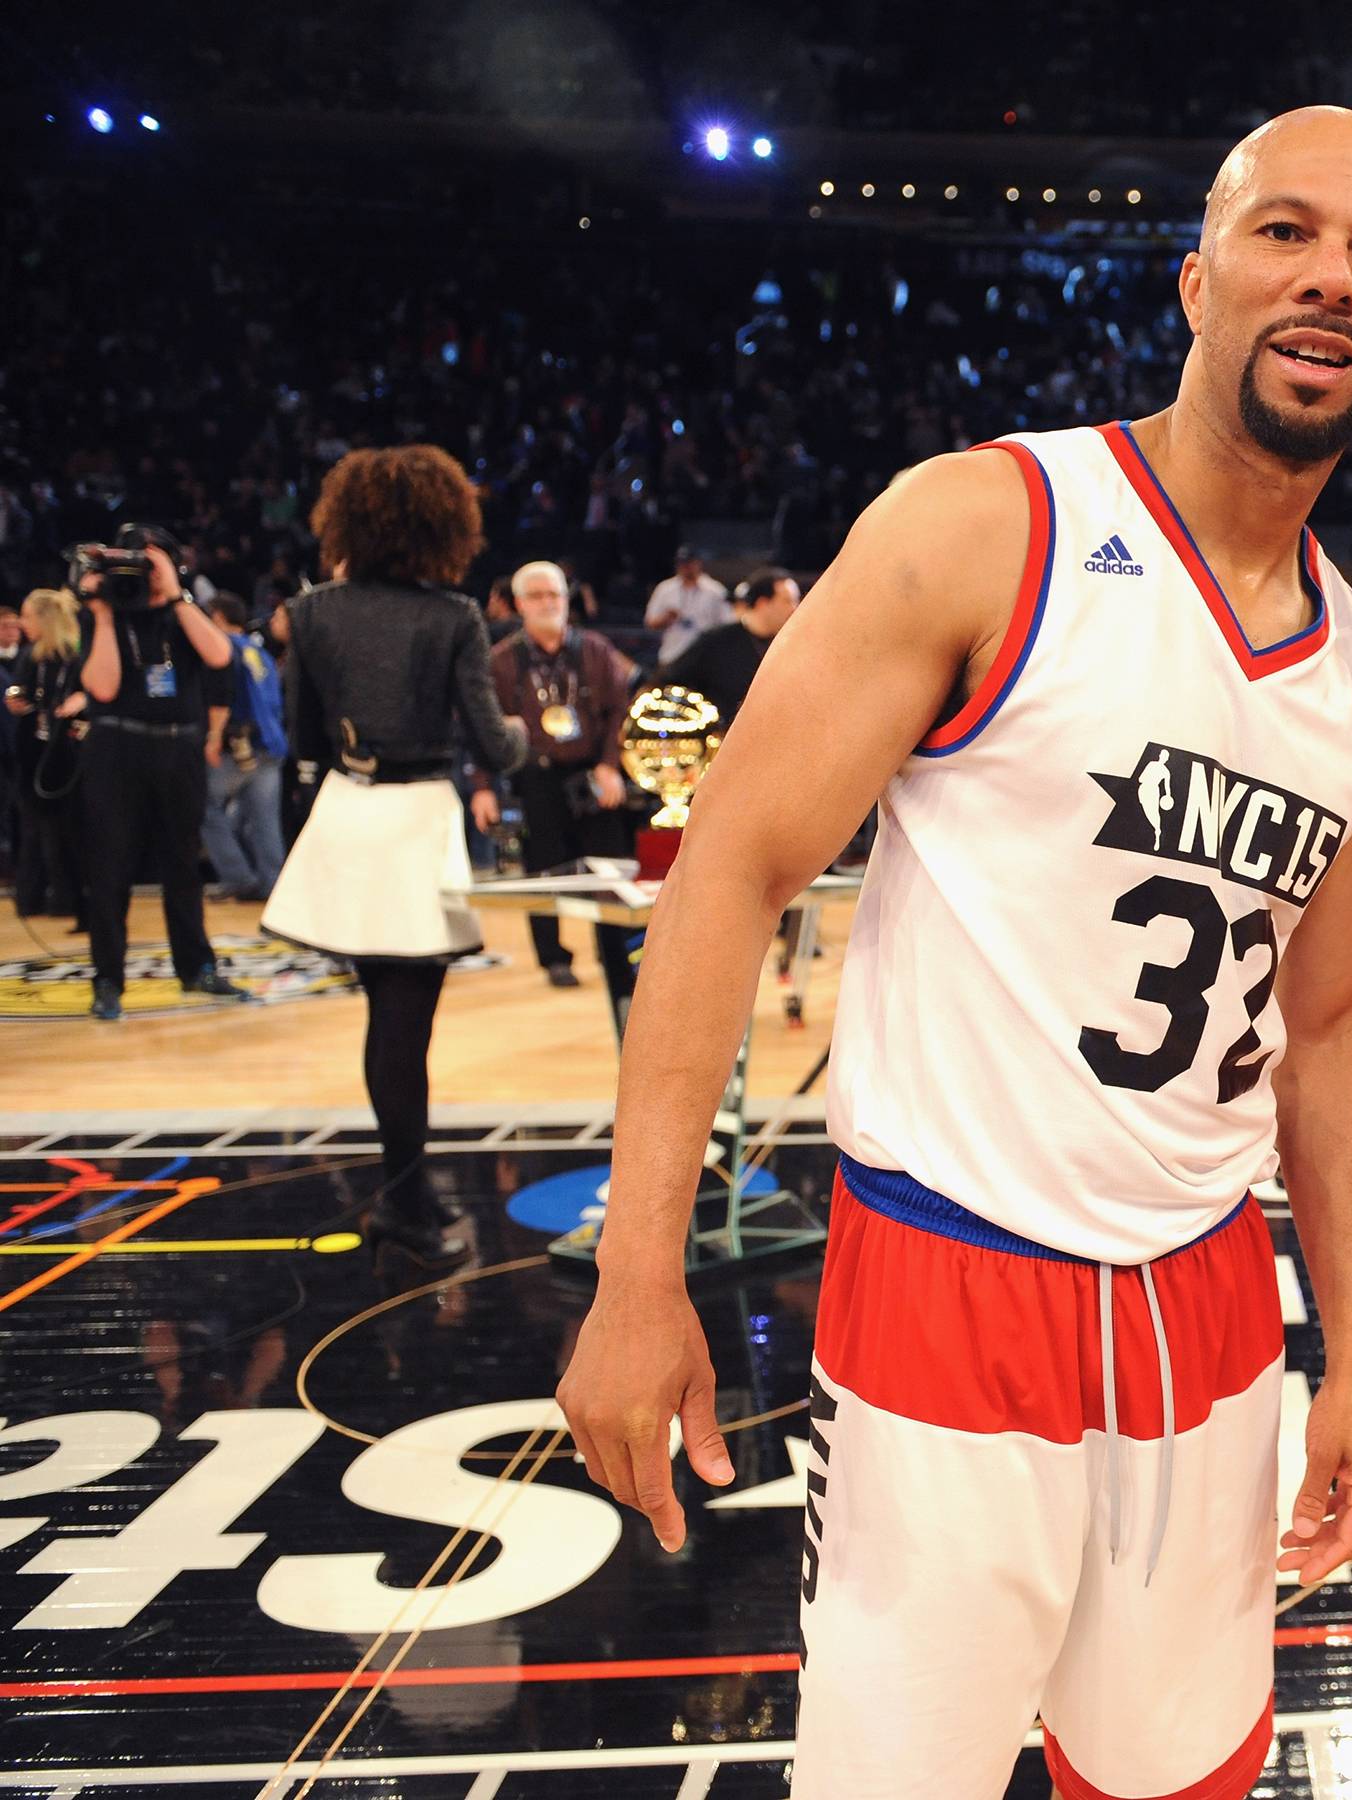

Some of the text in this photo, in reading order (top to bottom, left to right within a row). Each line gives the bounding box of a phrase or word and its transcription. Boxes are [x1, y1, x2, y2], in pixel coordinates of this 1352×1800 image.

[1084, 558, 1144, 577] adidas
[1178, 760, 1341, 900] NYC 15
[1077, 874, 1278, 1105] 32
